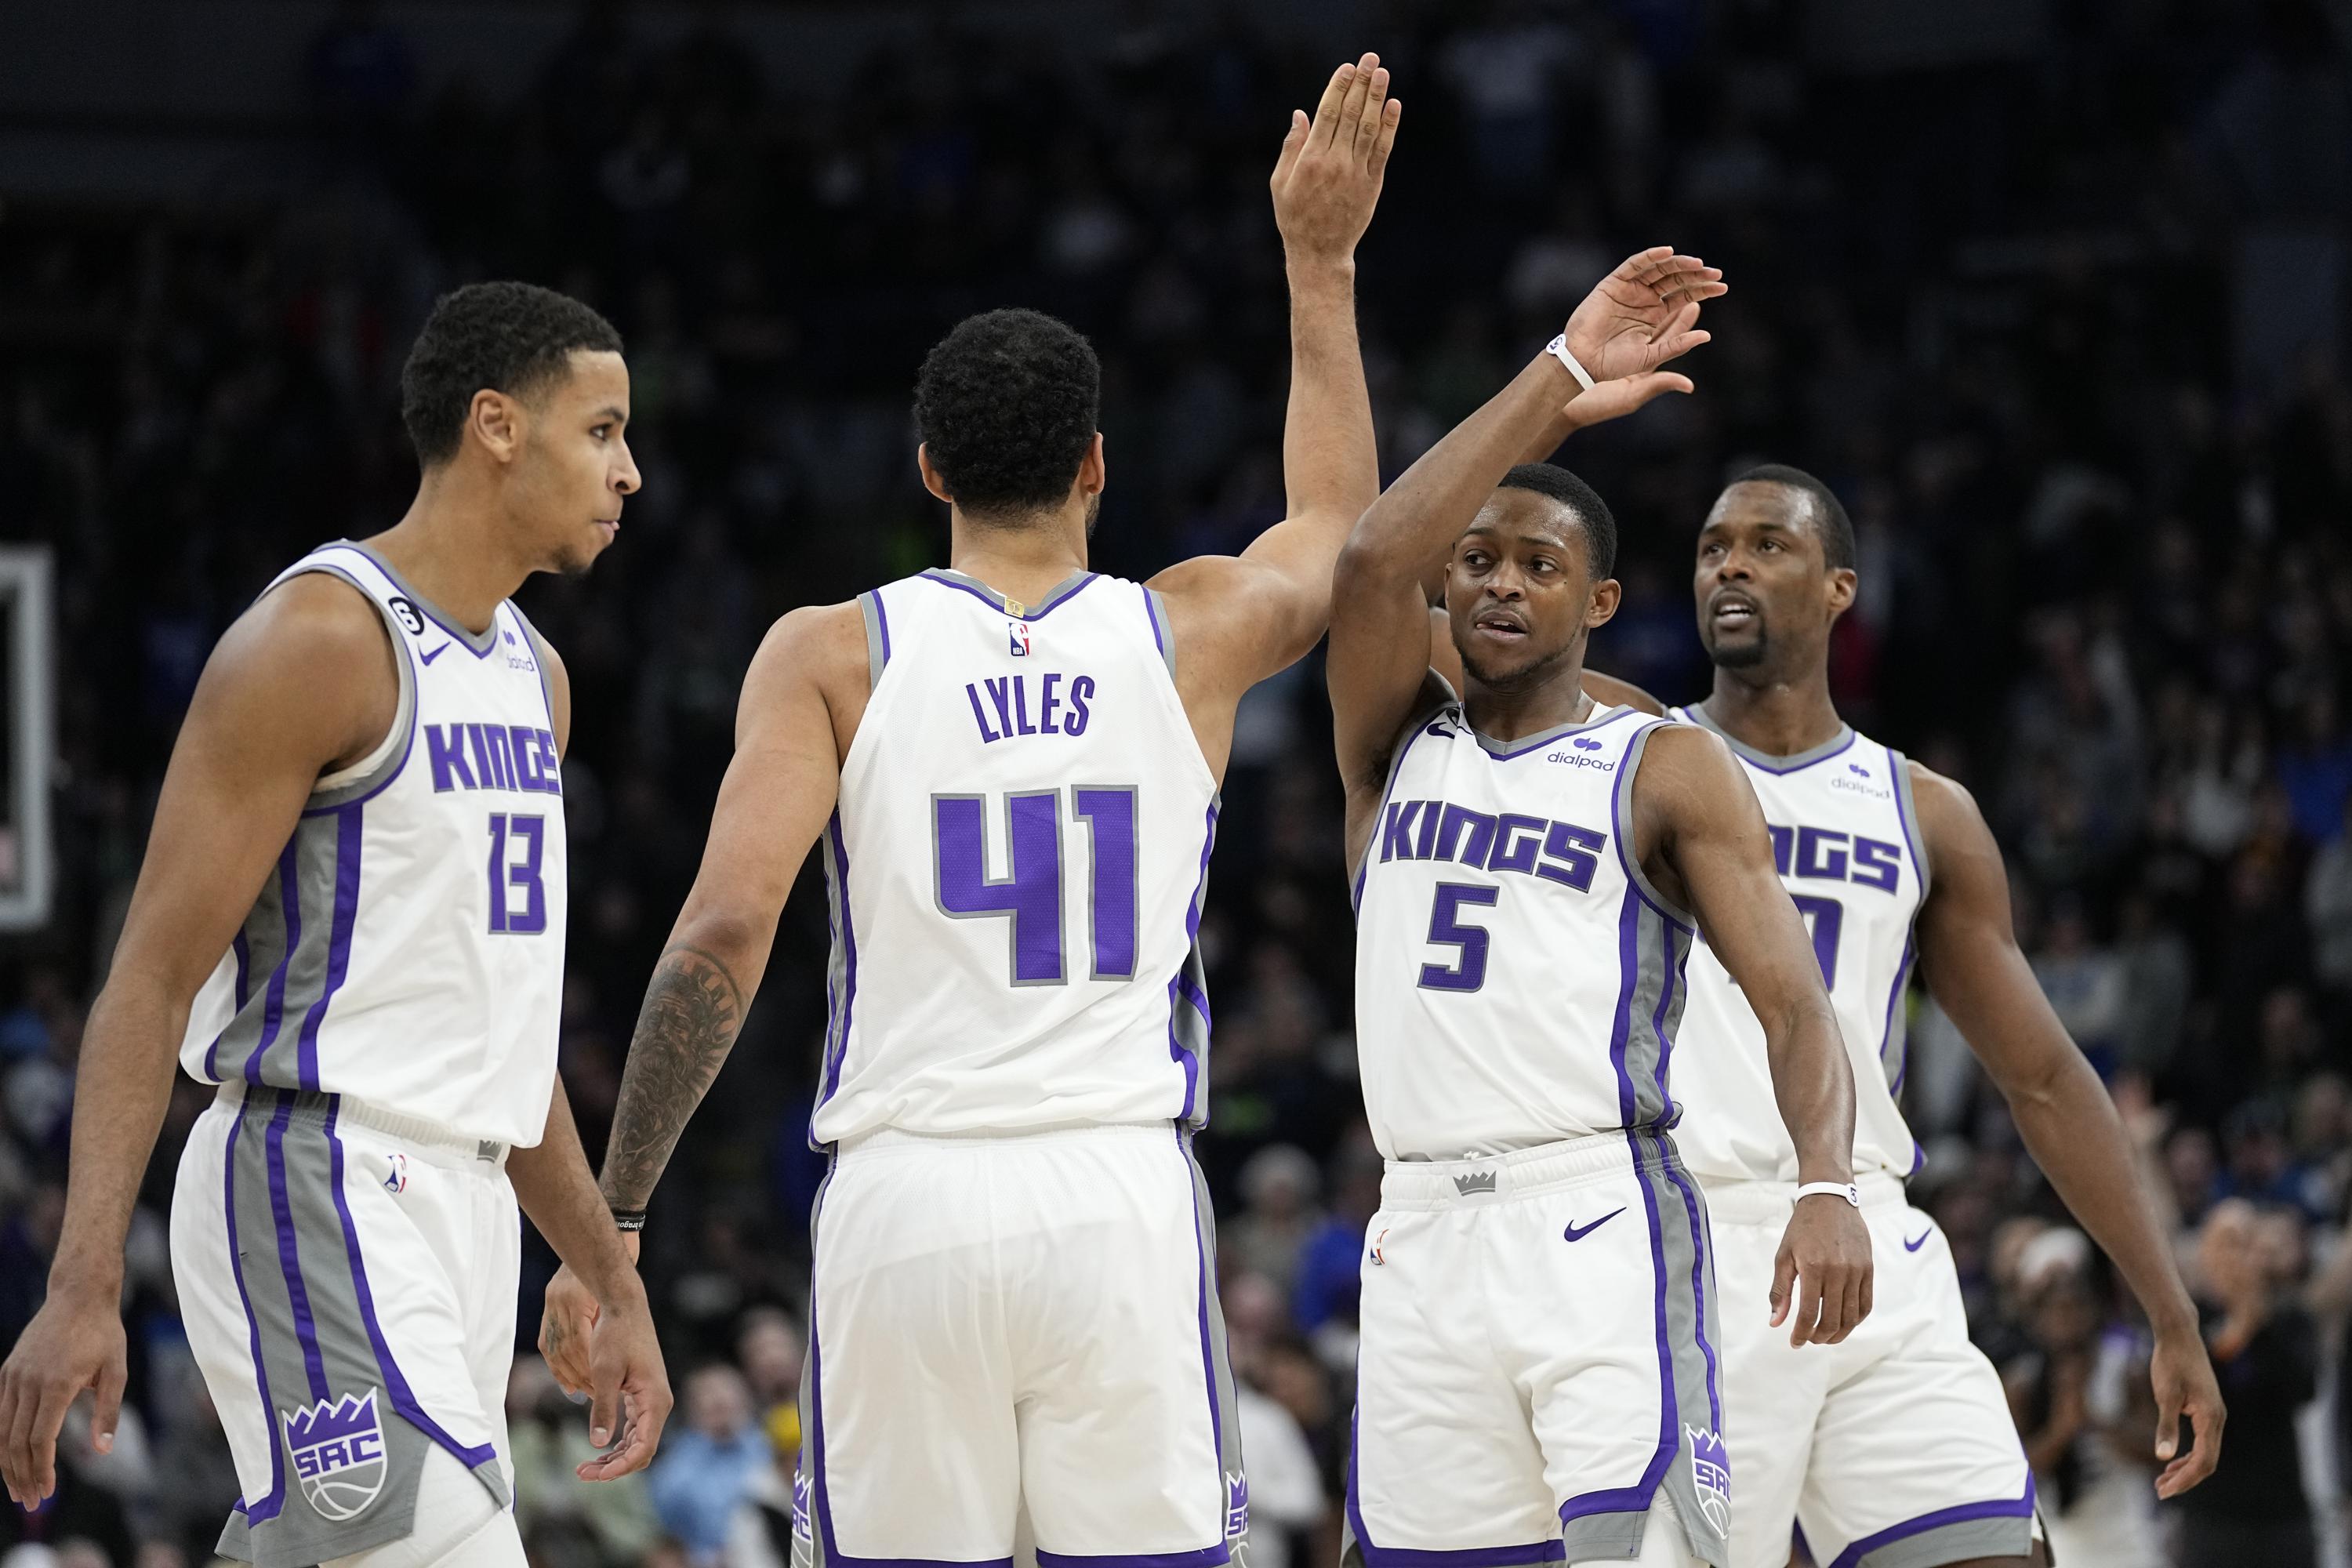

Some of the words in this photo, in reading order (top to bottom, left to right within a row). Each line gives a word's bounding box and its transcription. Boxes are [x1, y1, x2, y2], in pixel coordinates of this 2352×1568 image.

[391, 601, 421, 633] 6
[1013, 647, 1023, 655] NBA
[965, 673, 1096, 744] LYLES
[423, 722, 563, 797] KINGS
[1547, 751, 1616, 771] dialpad
[488, 811, 547, 936] 13
[1379, 800, 1608, 894] KINGS
[1766, 823, 1901, 897] NGS
[930, 783, 1140, 988] 41
[1417, 880, 1500, 993] 5
[293, 1432, 383, 1479] SAC
